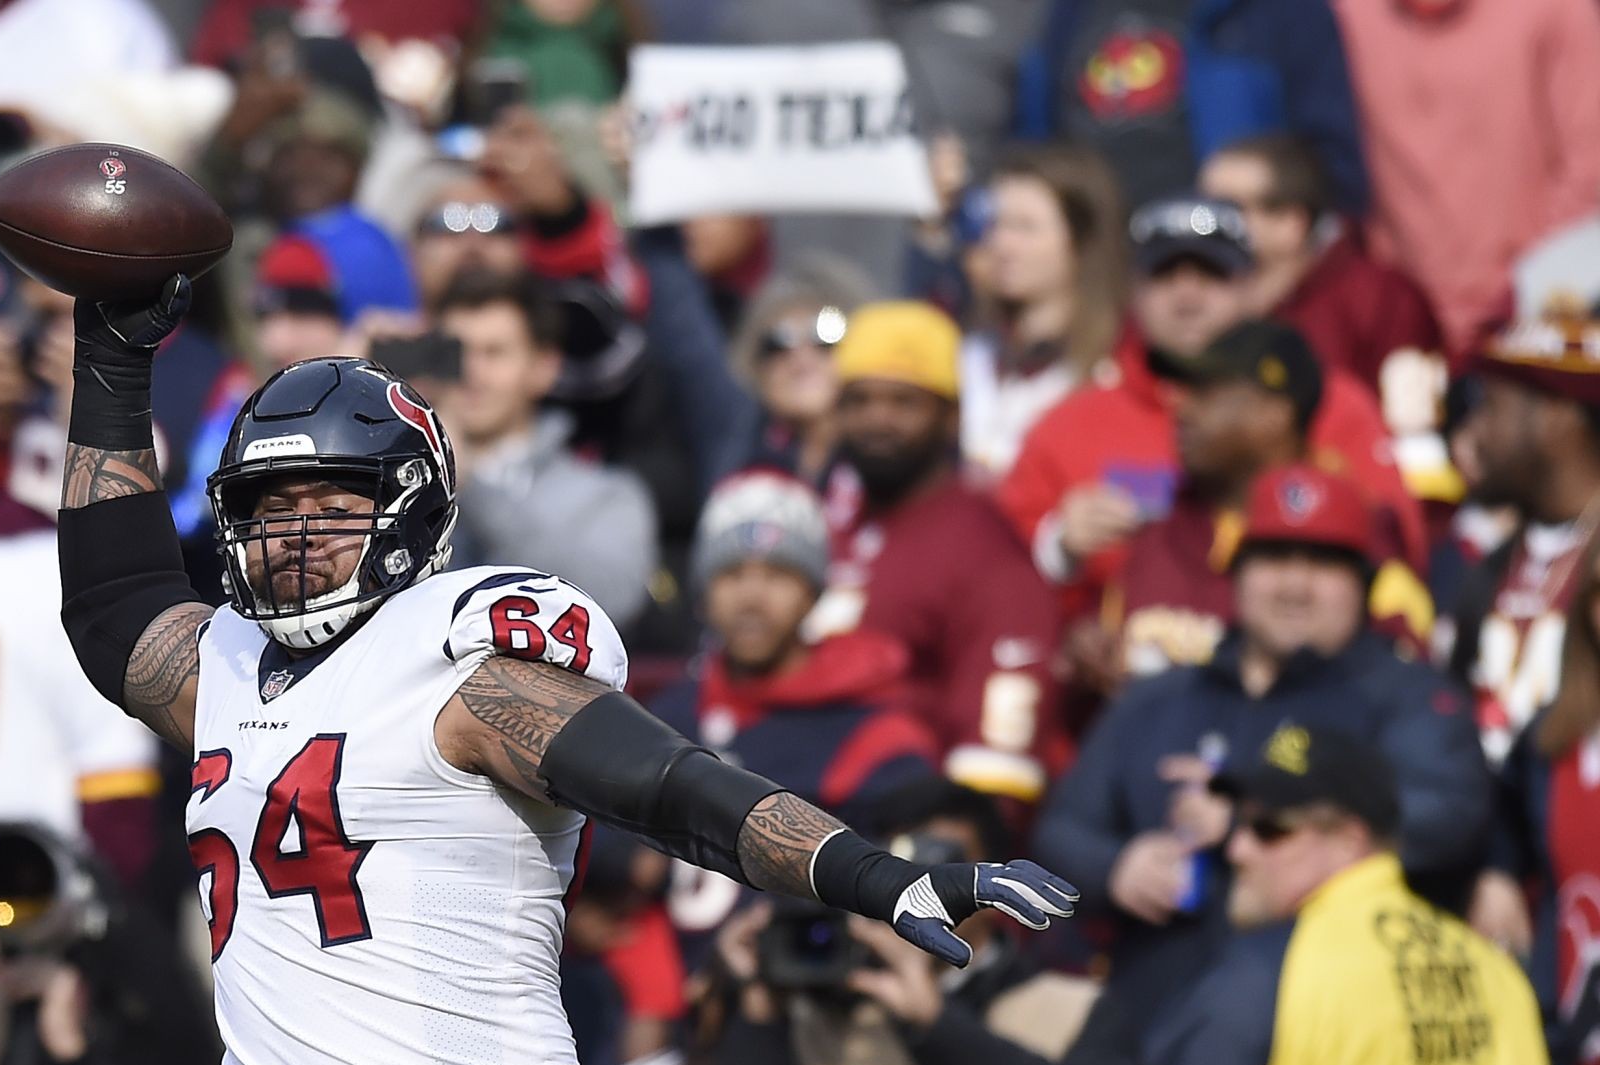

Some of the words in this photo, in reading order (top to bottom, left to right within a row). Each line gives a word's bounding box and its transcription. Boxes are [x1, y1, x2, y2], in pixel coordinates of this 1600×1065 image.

[104, 180, 127, 195] 55
[254, 440, 302, 451] TEXANS
[489, 595, 593, 674] 64
[238, 720, 290, 731] TEXANS
[187, 732, 378, 964] 64
